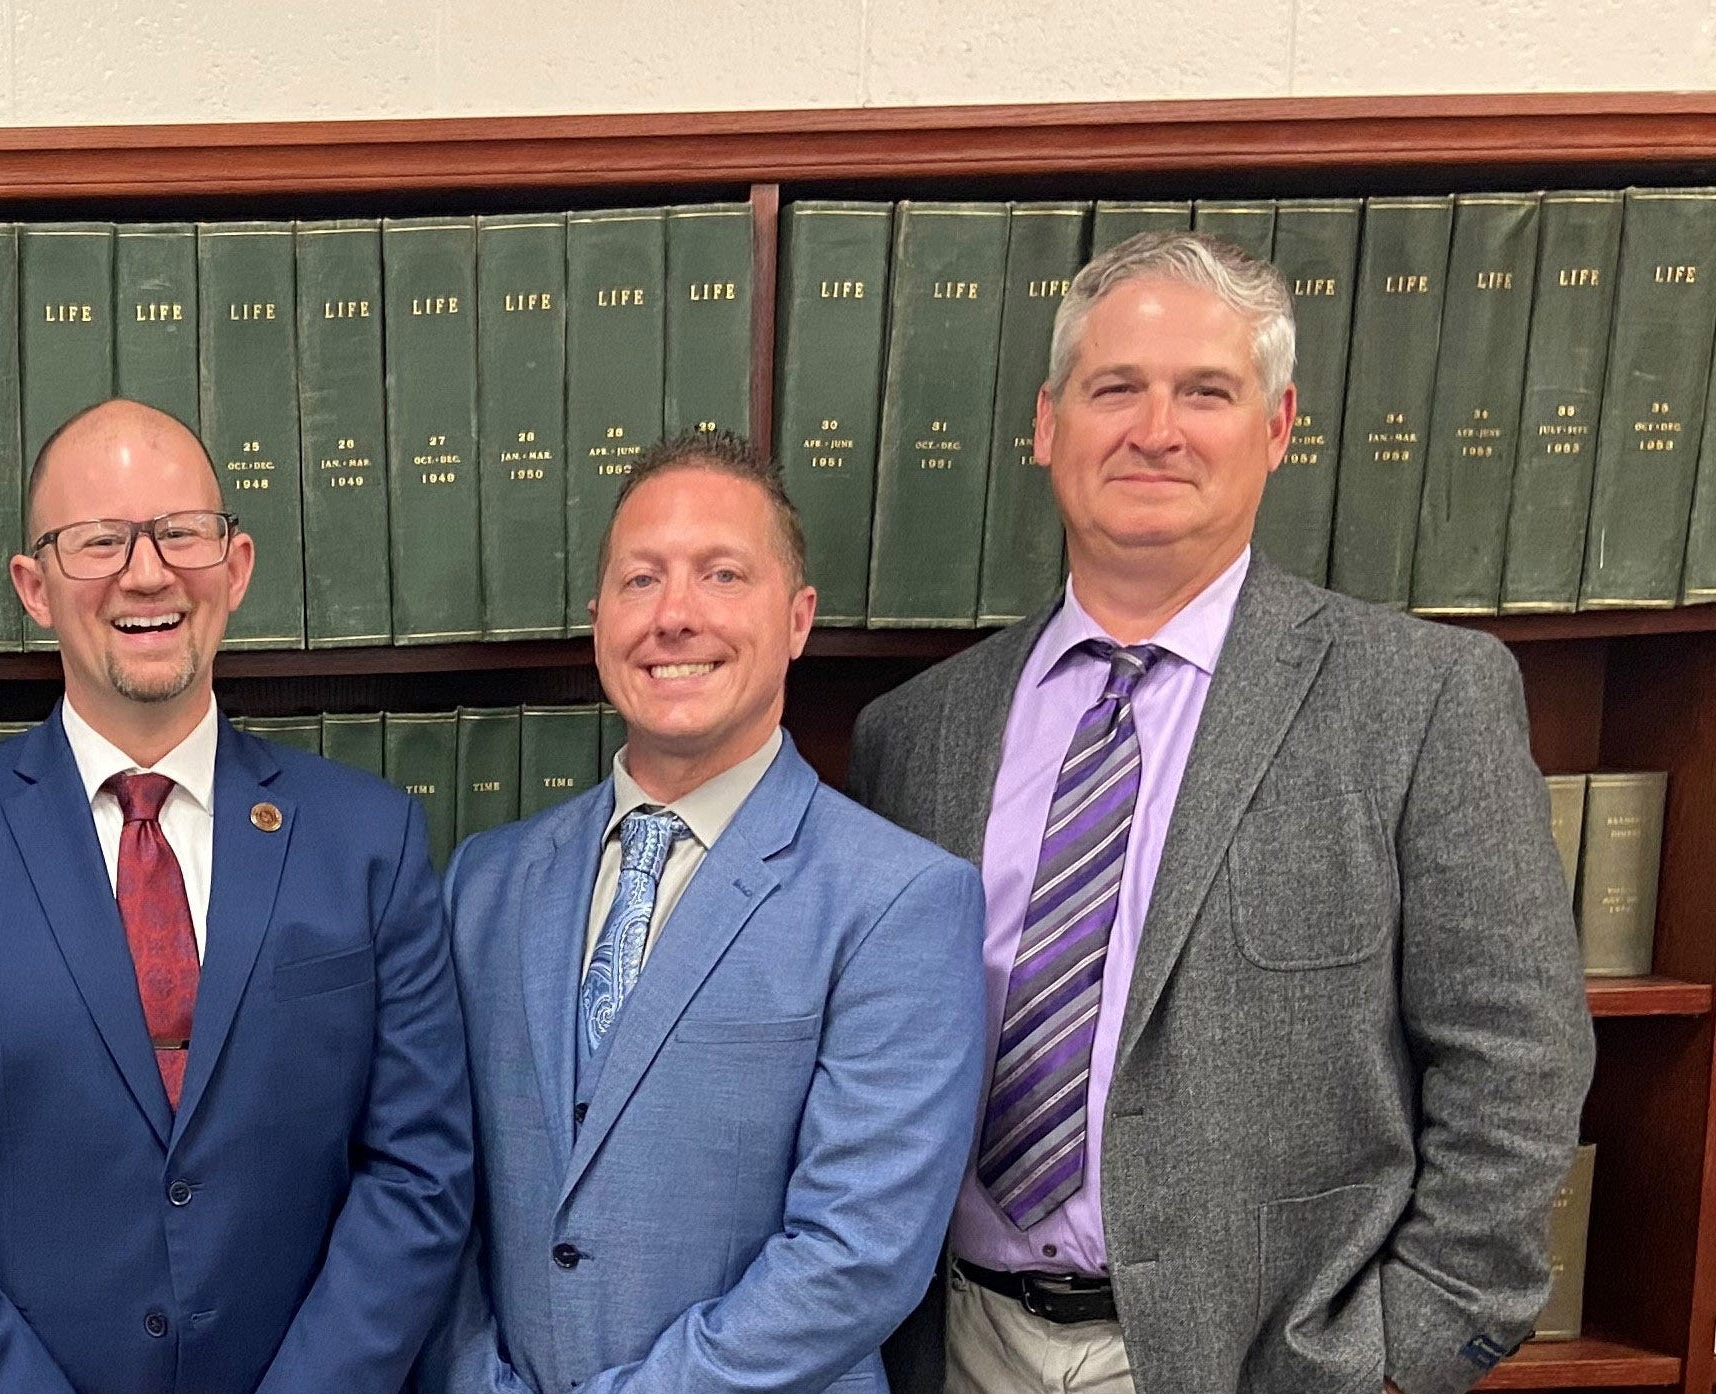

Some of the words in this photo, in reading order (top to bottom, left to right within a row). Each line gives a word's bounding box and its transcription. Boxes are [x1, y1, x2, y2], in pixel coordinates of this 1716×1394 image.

[1477, 271, 1512, 290] LIFE
[1559, 269, 1600, 287] LIFE
[1655, 265, 1696, 283] LIFE
[690, 283, 735, 300] LIFE
[821, 282, 864, 298] LIFE
[933, 282, 978, 299] LIFE
[1029, 280, 1070, 297] LIFE
[1294, 279, 1335, 297] LIFE
[1386, 276, 1428, 293] LIFE
[412, 297, 458, 315] LIFE
[505, 294, 551, 311] LIFE
[598, 289, 644, 306] LIFE
[45, 306, 92, 322] LIFE
[136, 304, 182, 321] LIFE
[230, 304, 276, 320] LIFE
[325, 301, 370, 318] LIFE
[821, 420, 838, 431] 30
[243, 441, 260, 452] 25
[429, 436, 446, 447] 27
[330, 475, 364, 487] 1949
[422, 472, 455, 484] 1949
[510, 469, 544, 480] 1950
[405, 784, 435, 794] TIME
[473, 781, 501, 792] TIME
[543, 777, 574, 788] TIME
